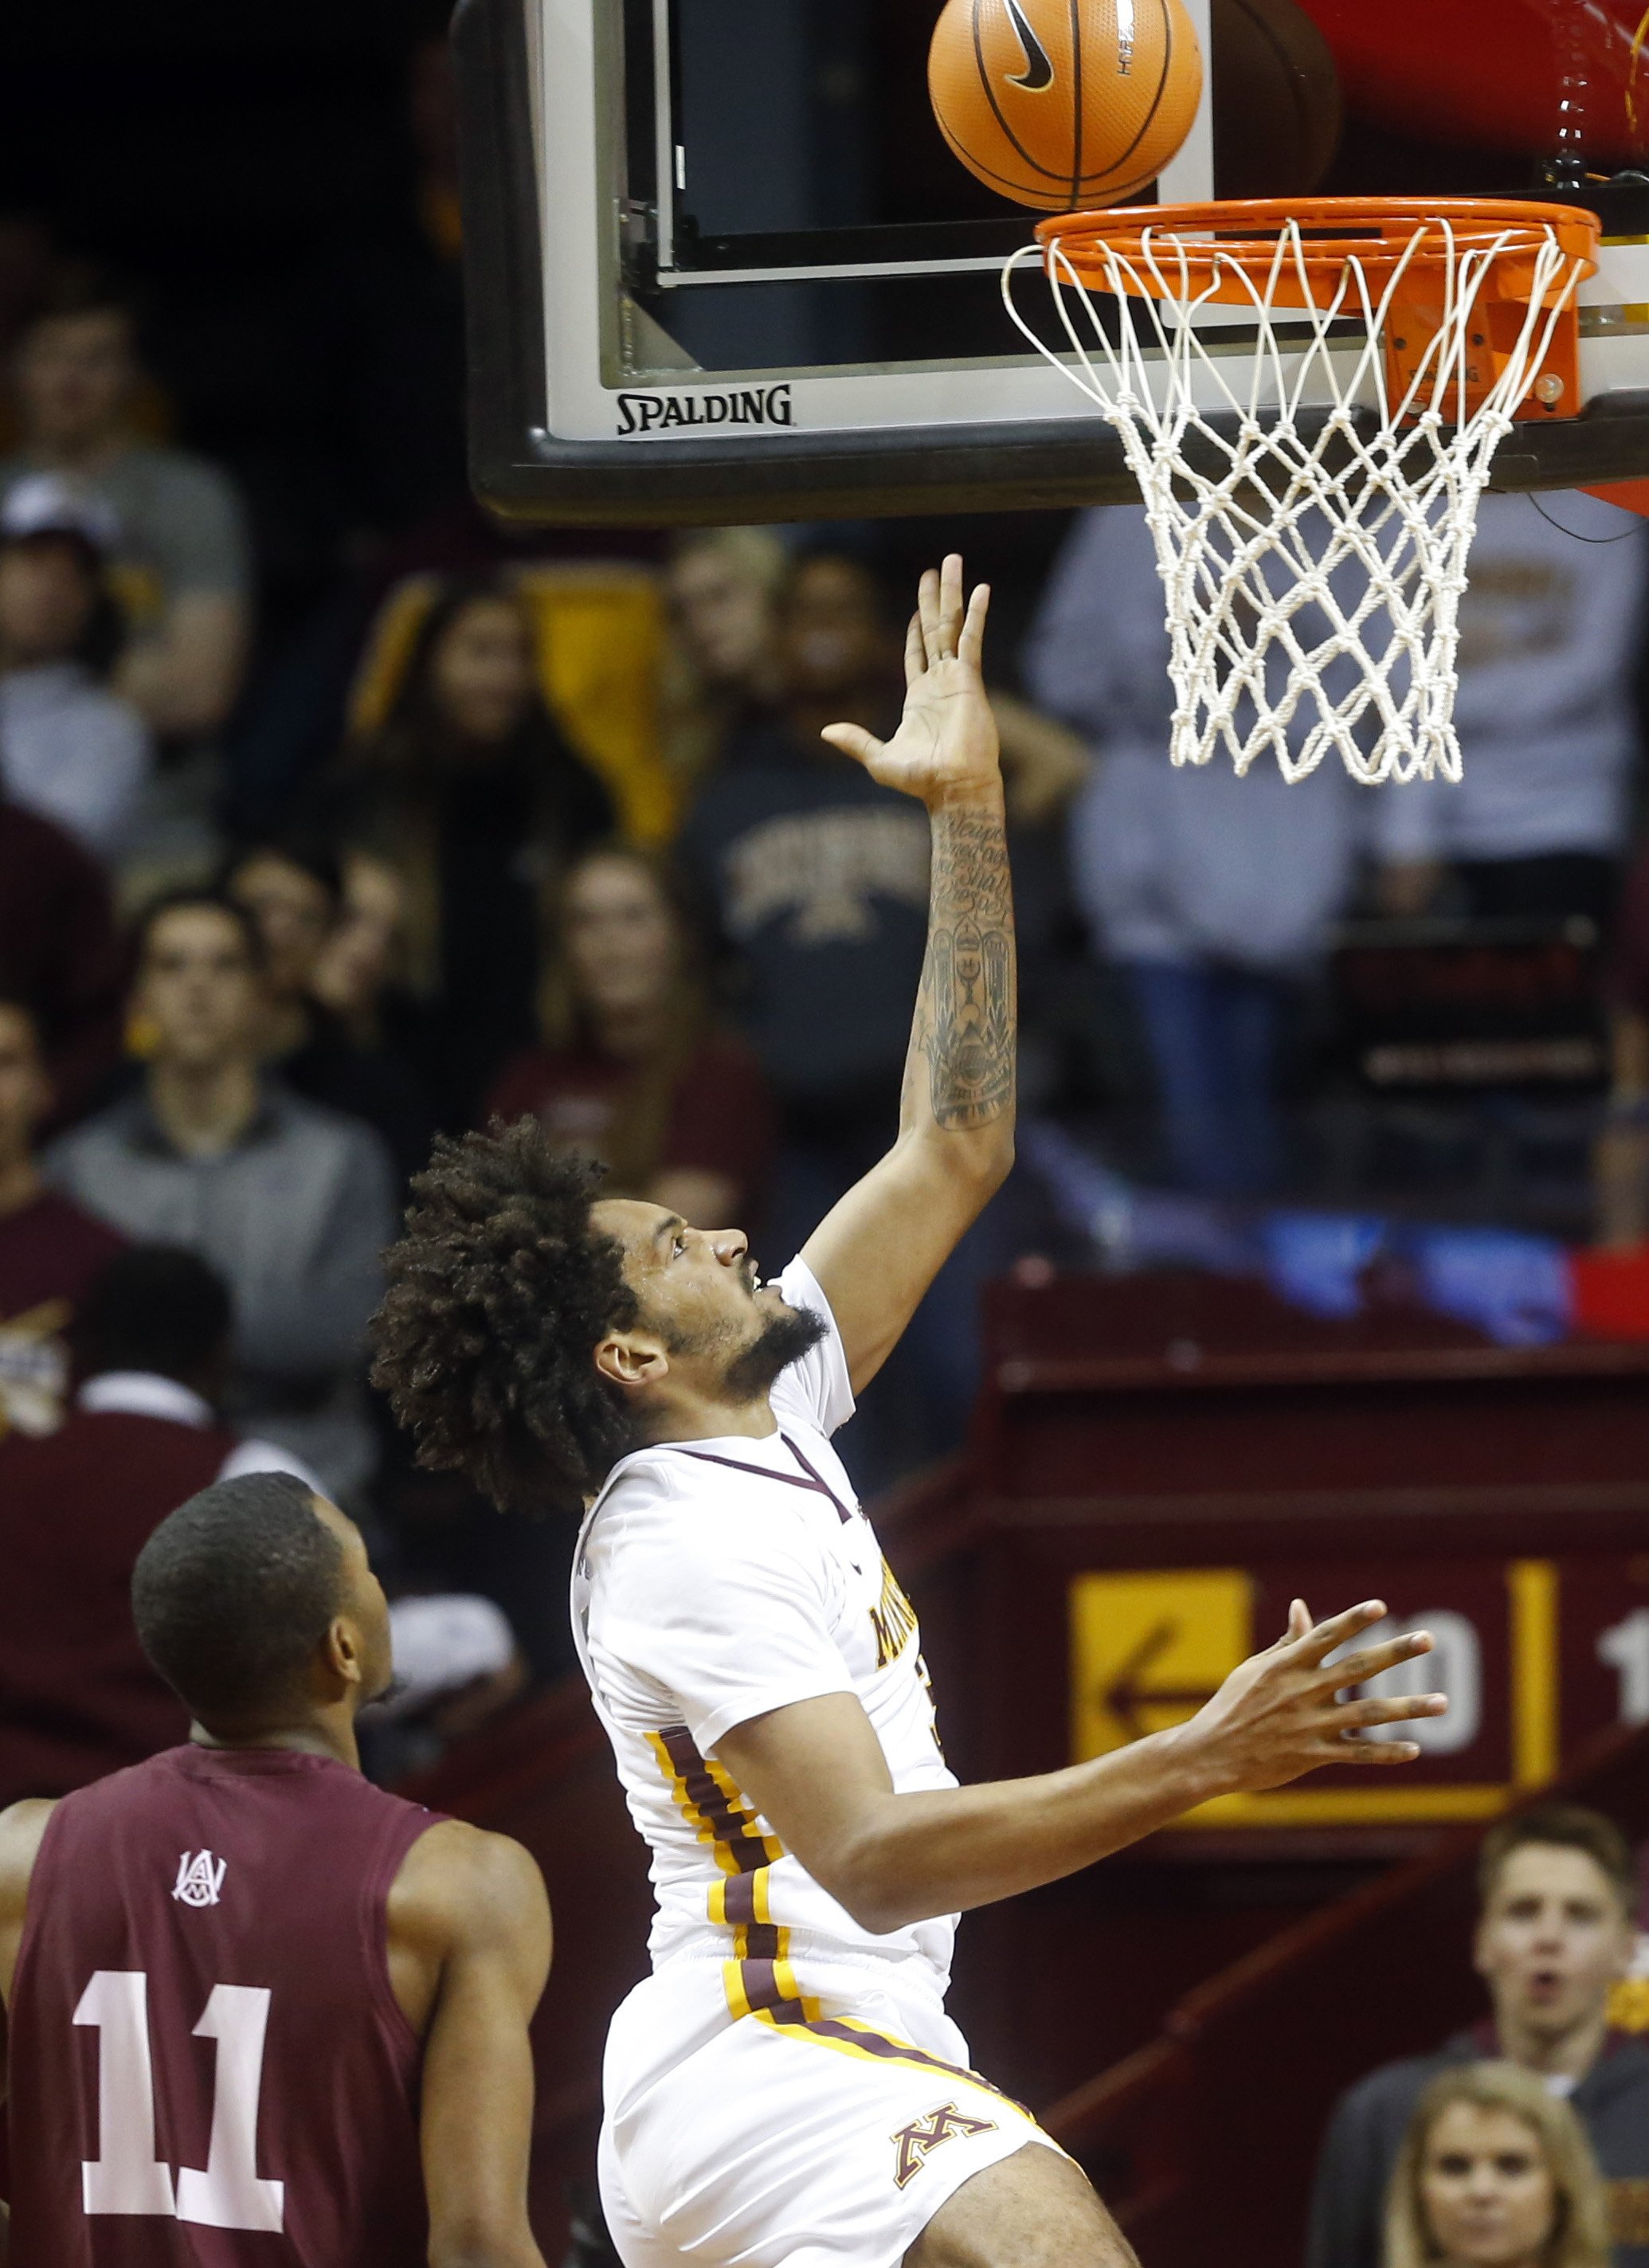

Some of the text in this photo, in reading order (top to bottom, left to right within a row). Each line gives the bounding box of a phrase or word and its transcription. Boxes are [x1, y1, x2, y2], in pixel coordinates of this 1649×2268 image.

[617, 384, 792, 435] SPALDING
[72, 1969, 284, 2234] 11
[889, 2101, 999, 2191] M
